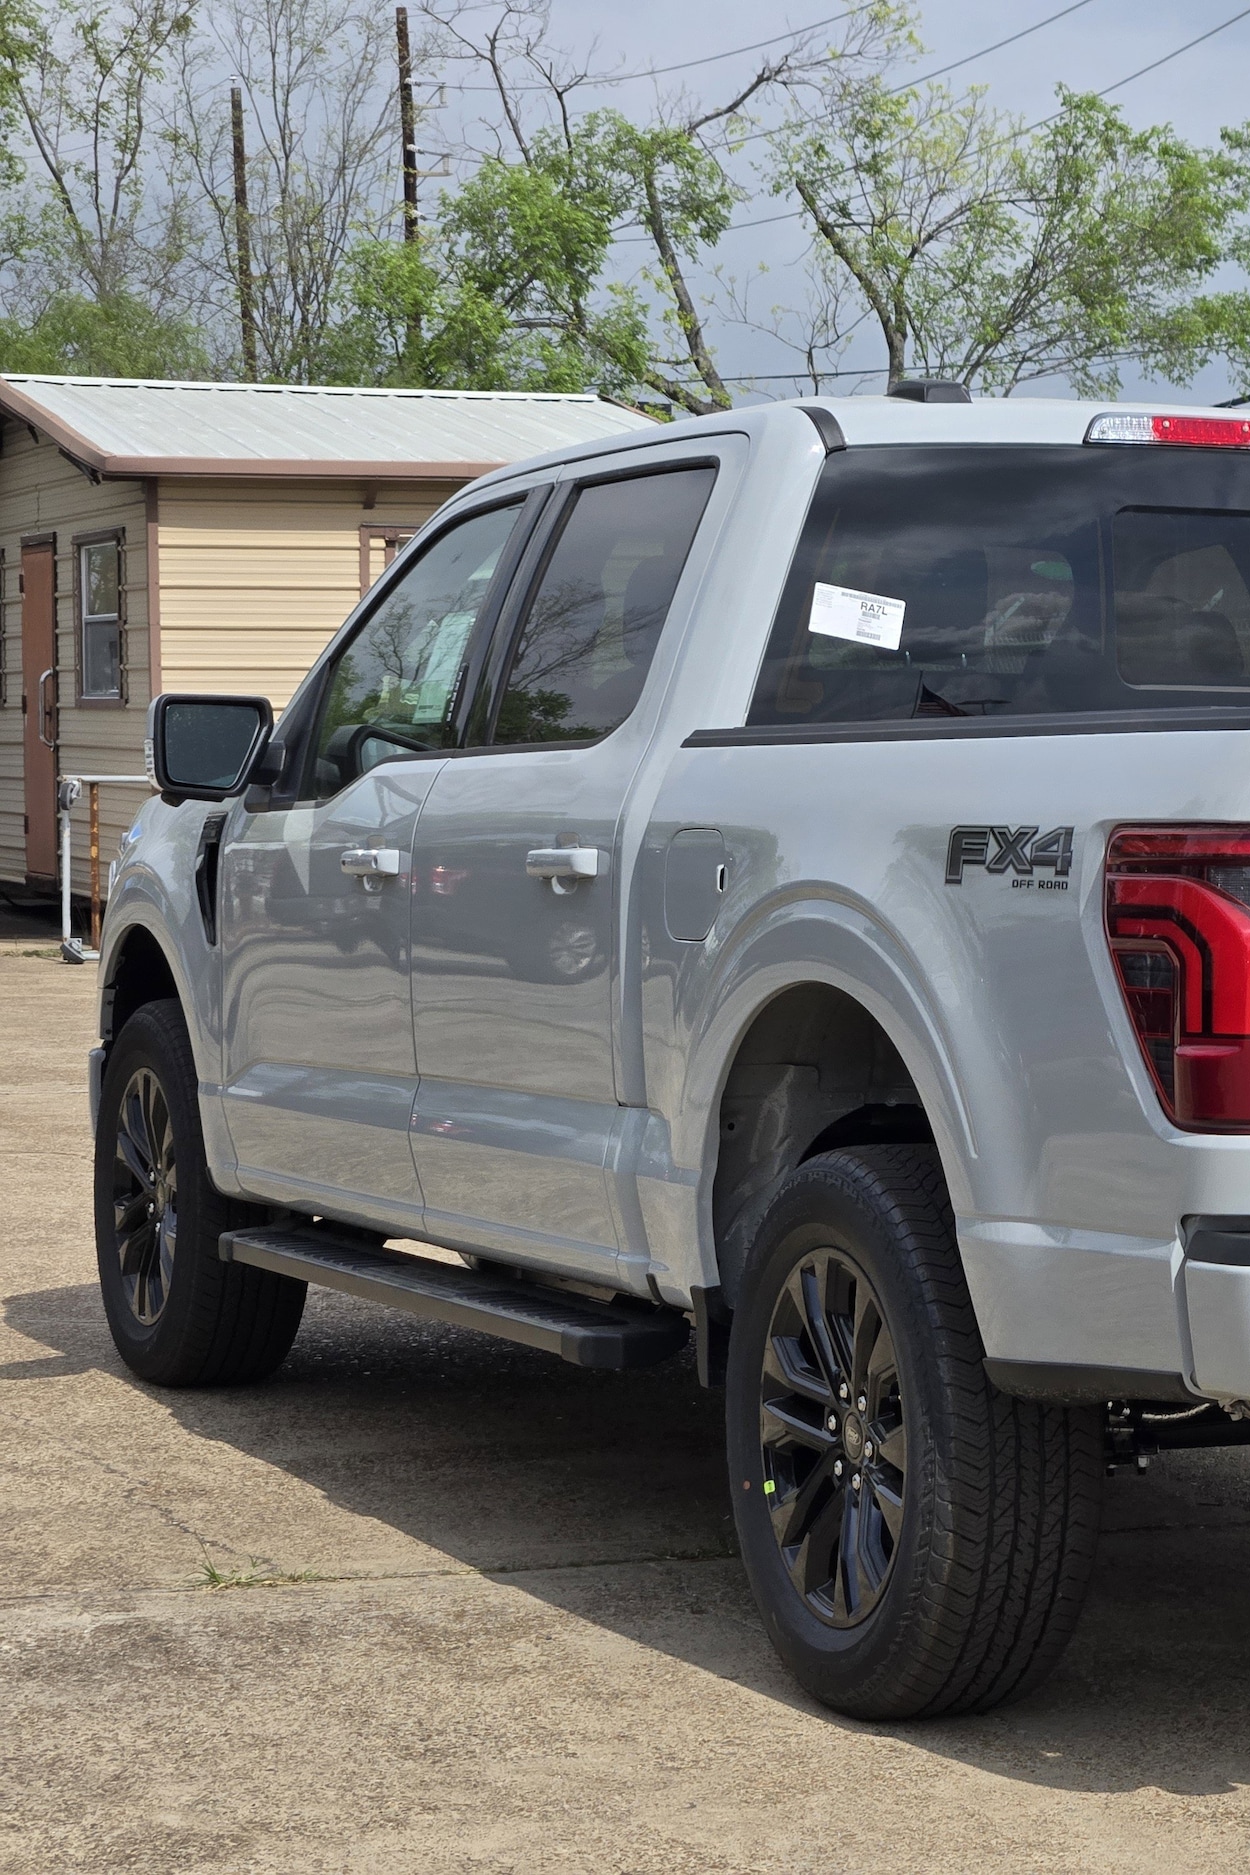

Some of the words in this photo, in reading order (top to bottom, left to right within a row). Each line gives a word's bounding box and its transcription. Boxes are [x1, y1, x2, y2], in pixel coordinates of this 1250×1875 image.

[860, 601, 888, 616] RA7L
[945, 825, 1075, 885] FX4
[1011, 879, 1034, 889] OFF
[1038, 880, 1068, 890] ROAD
